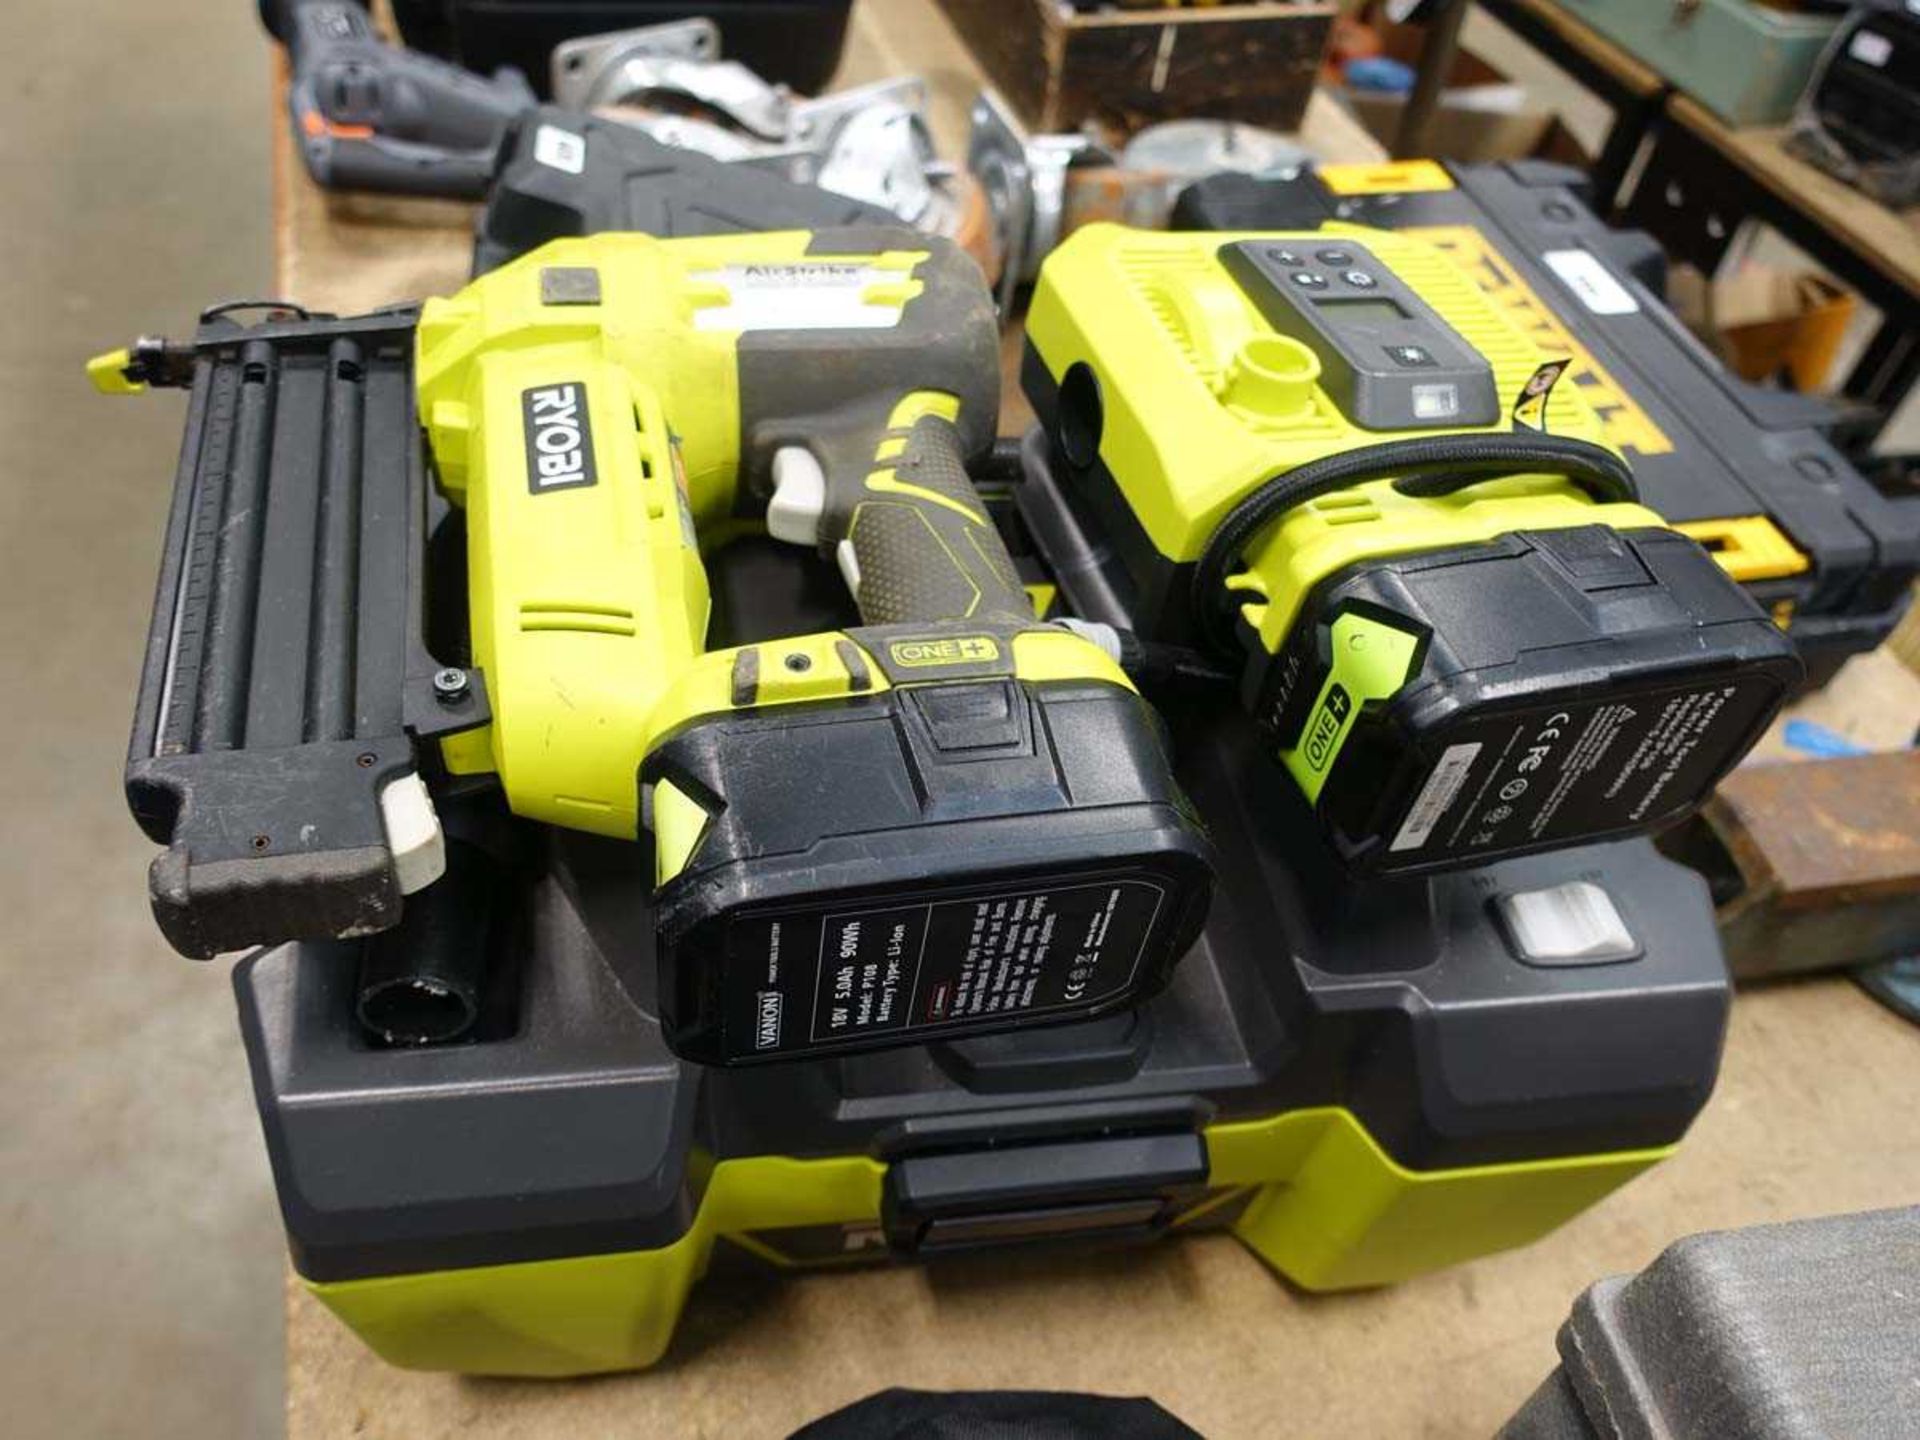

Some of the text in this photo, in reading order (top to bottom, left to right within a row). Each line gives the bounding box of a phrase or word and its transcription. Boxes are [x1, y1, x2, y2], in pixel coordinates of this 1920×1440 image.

[532, 385, 585, 486] RYOBI
[761, 997, 779, 1046] VANON
[831, 922, 861, 1028] 18V 5.0Ah 90Wh
[856, 963, 878, 1025] Model: P108
[876, 924, 906, 1022] Battery Type: Li-Ion
